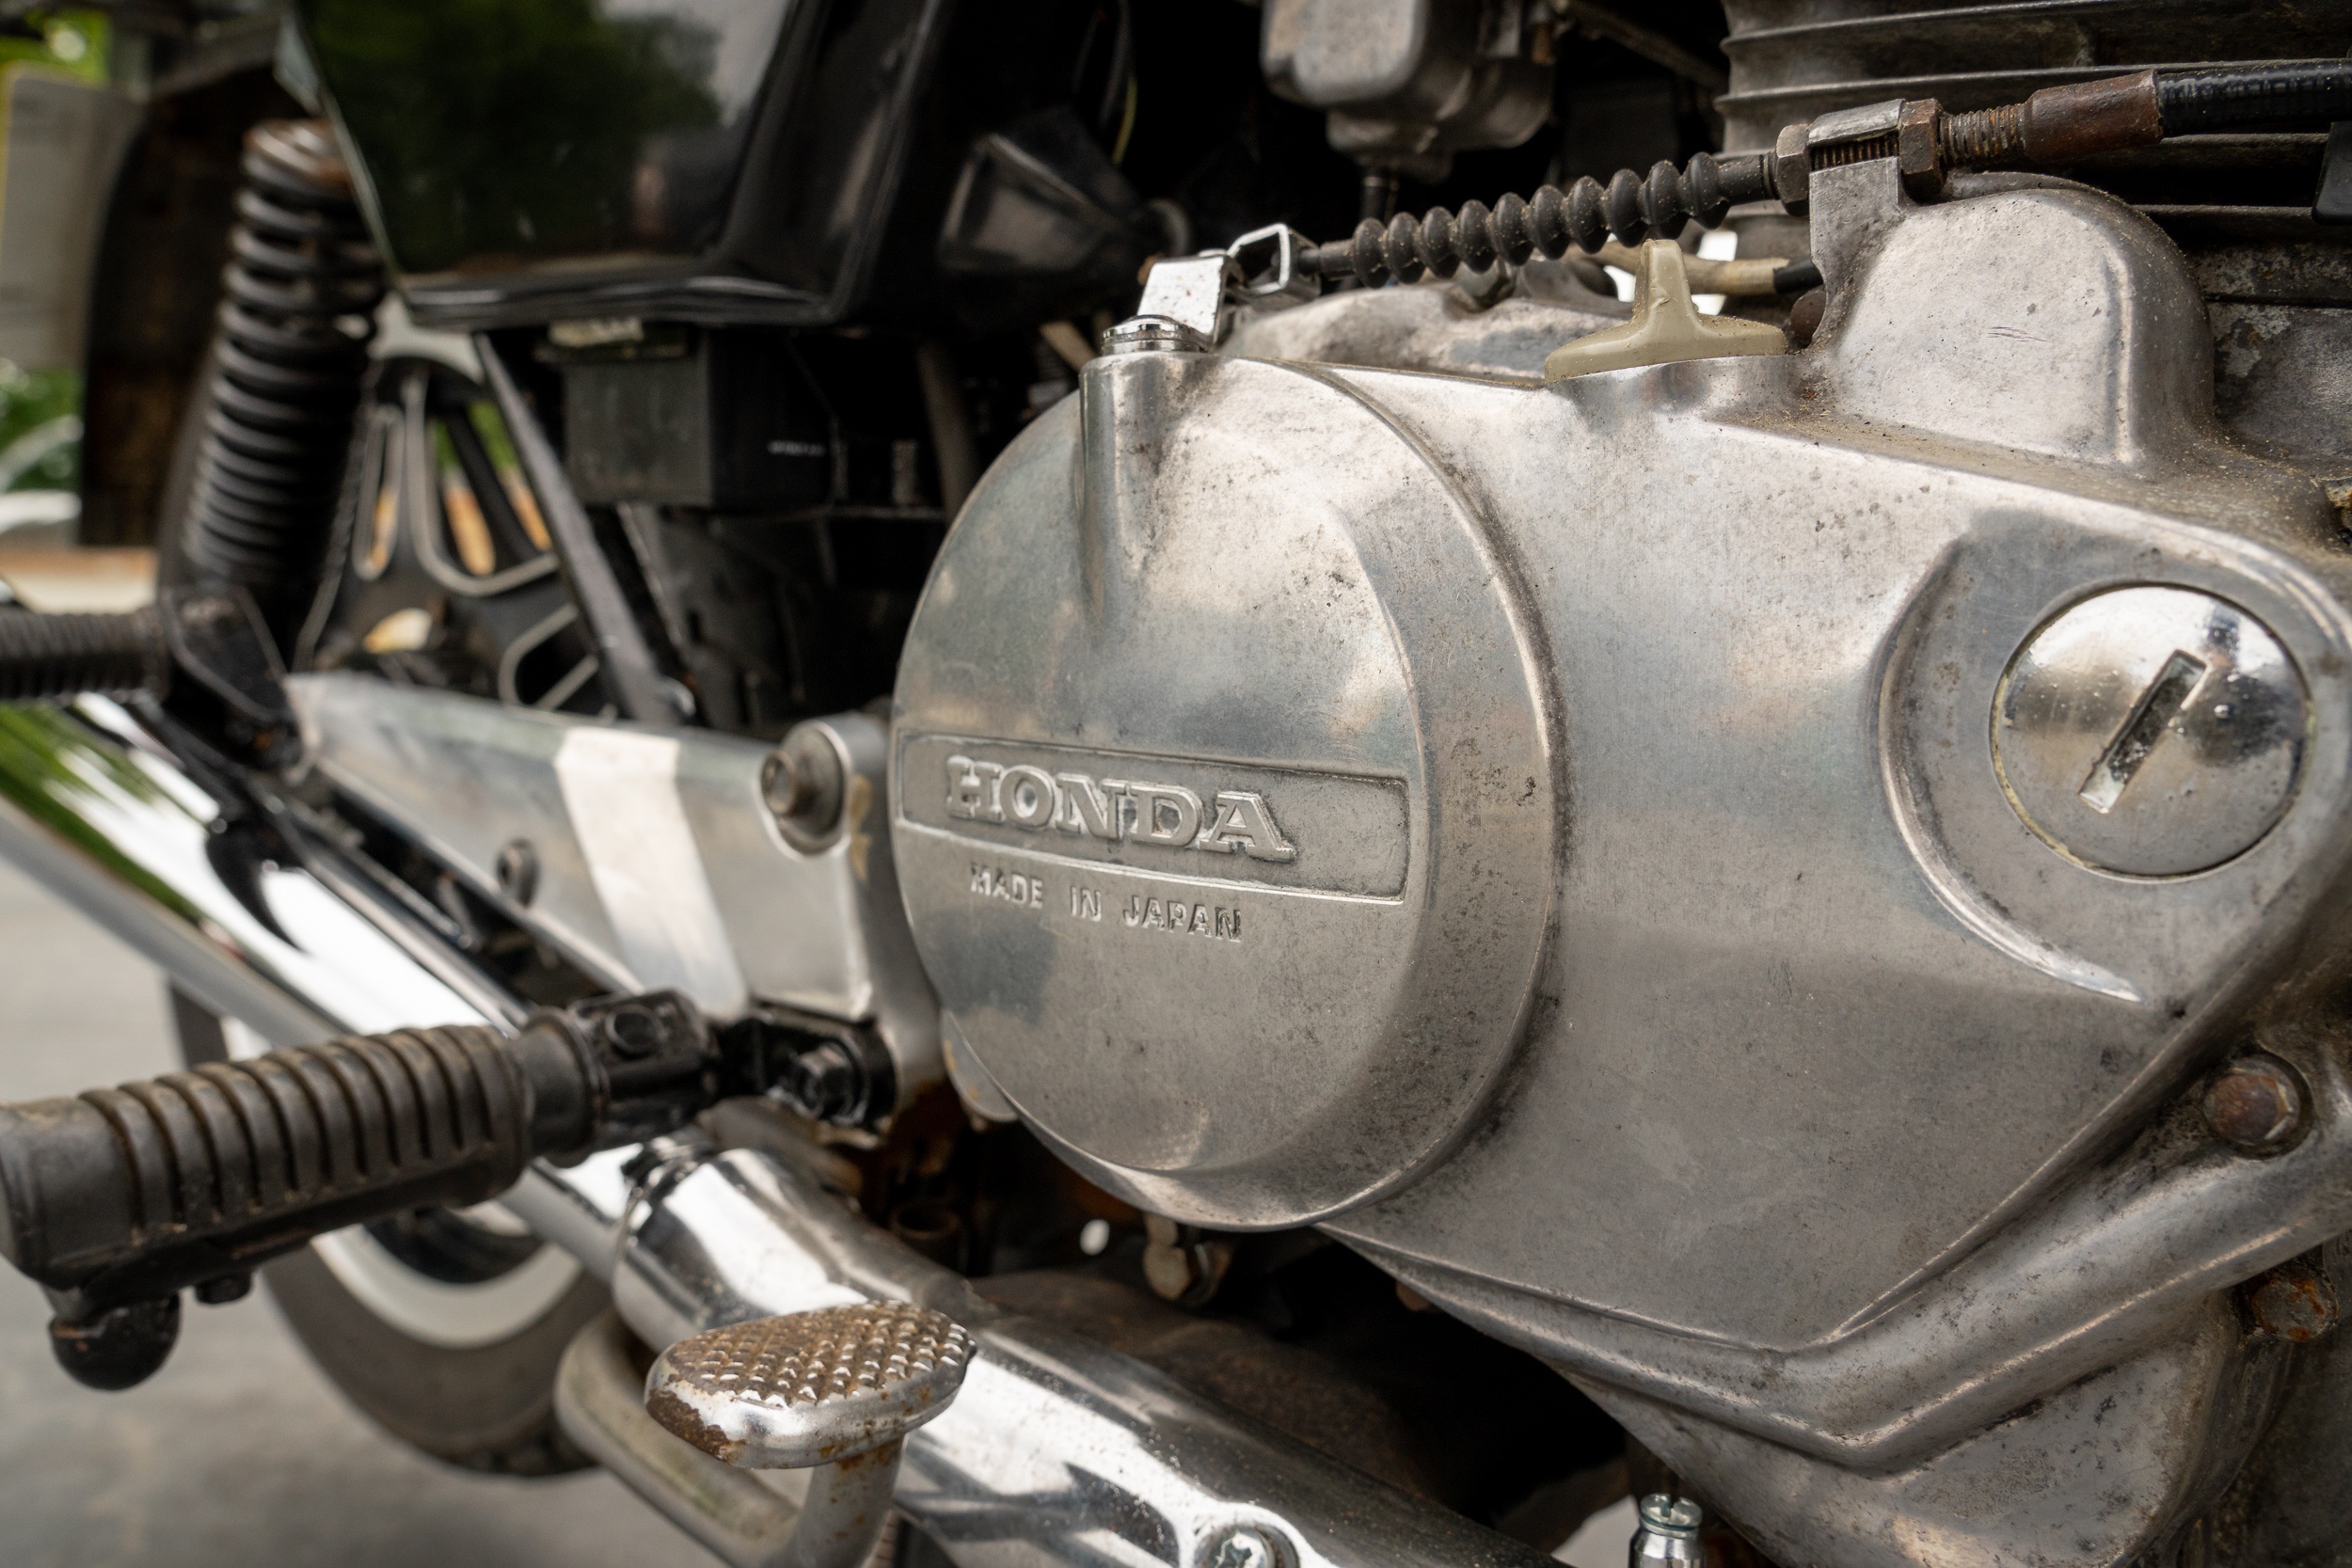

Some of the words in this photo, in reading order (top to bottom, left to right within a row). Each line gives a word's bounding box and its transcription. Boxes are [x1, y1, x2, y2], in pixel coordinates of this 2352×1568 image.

[946, 755, 1296, 863] HONDA
[969, 863, 1044, 909] MADE
[1070, 885, 1103, 921] IN
[1121, 895, 1243, 942] JAPAN
